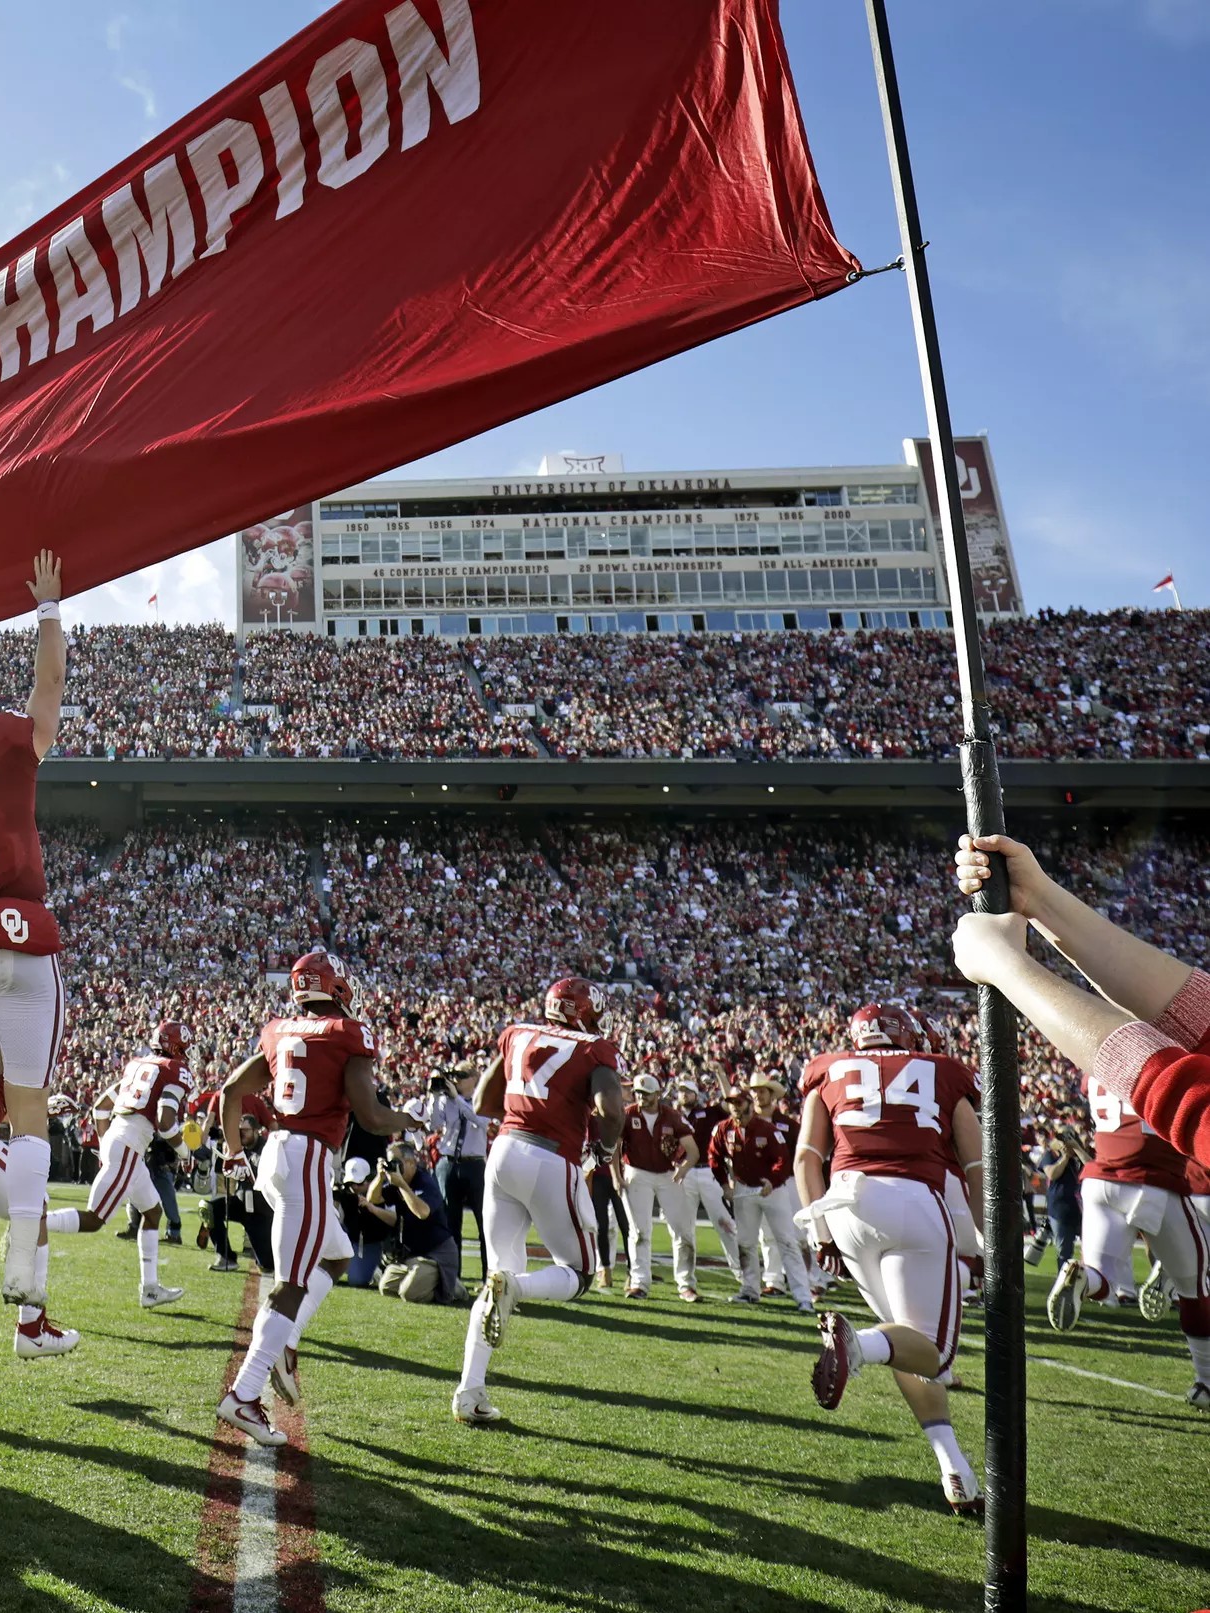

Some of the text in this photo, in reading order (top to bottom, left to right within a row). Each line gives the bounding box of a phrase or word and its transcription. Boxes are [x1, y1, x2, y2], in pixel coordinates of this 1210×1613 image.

[493, 478, 731, 496] UNIVERSITY OF OKLAHOMA
[346, 523, 369, 532] 1950
[387, 522, 410, 531] 1955
[429, 520, 452, 529] 1956
[471, 520, 495, 528] 1974
[523, 516, 601, 527] NATIONAL
[611, 513, 703, 525] CHAMPIONS
[824, 510, 851, 519] 2000
[390, 567, 458, 577] CONFERENCE
[462, 565, 550, 576] CHAMPIONSHIPS
[598, 563, 628, 572] BOWL
[632, 561, 723, 571] CHAMPIONSHIPS
[783, 558, 878, 569] ALL-AMERICANS
[0, 908, 29, 944] OU
[298, 975, 306, 989] 6
[860, 1018, 880, 1035] 34
[360, 1025, 375, 1050] 6
[273, 1036, 307, 1115] 6
[506, 1031, 578, 1100] 17
[828, 1058, 942, 1135] 34
